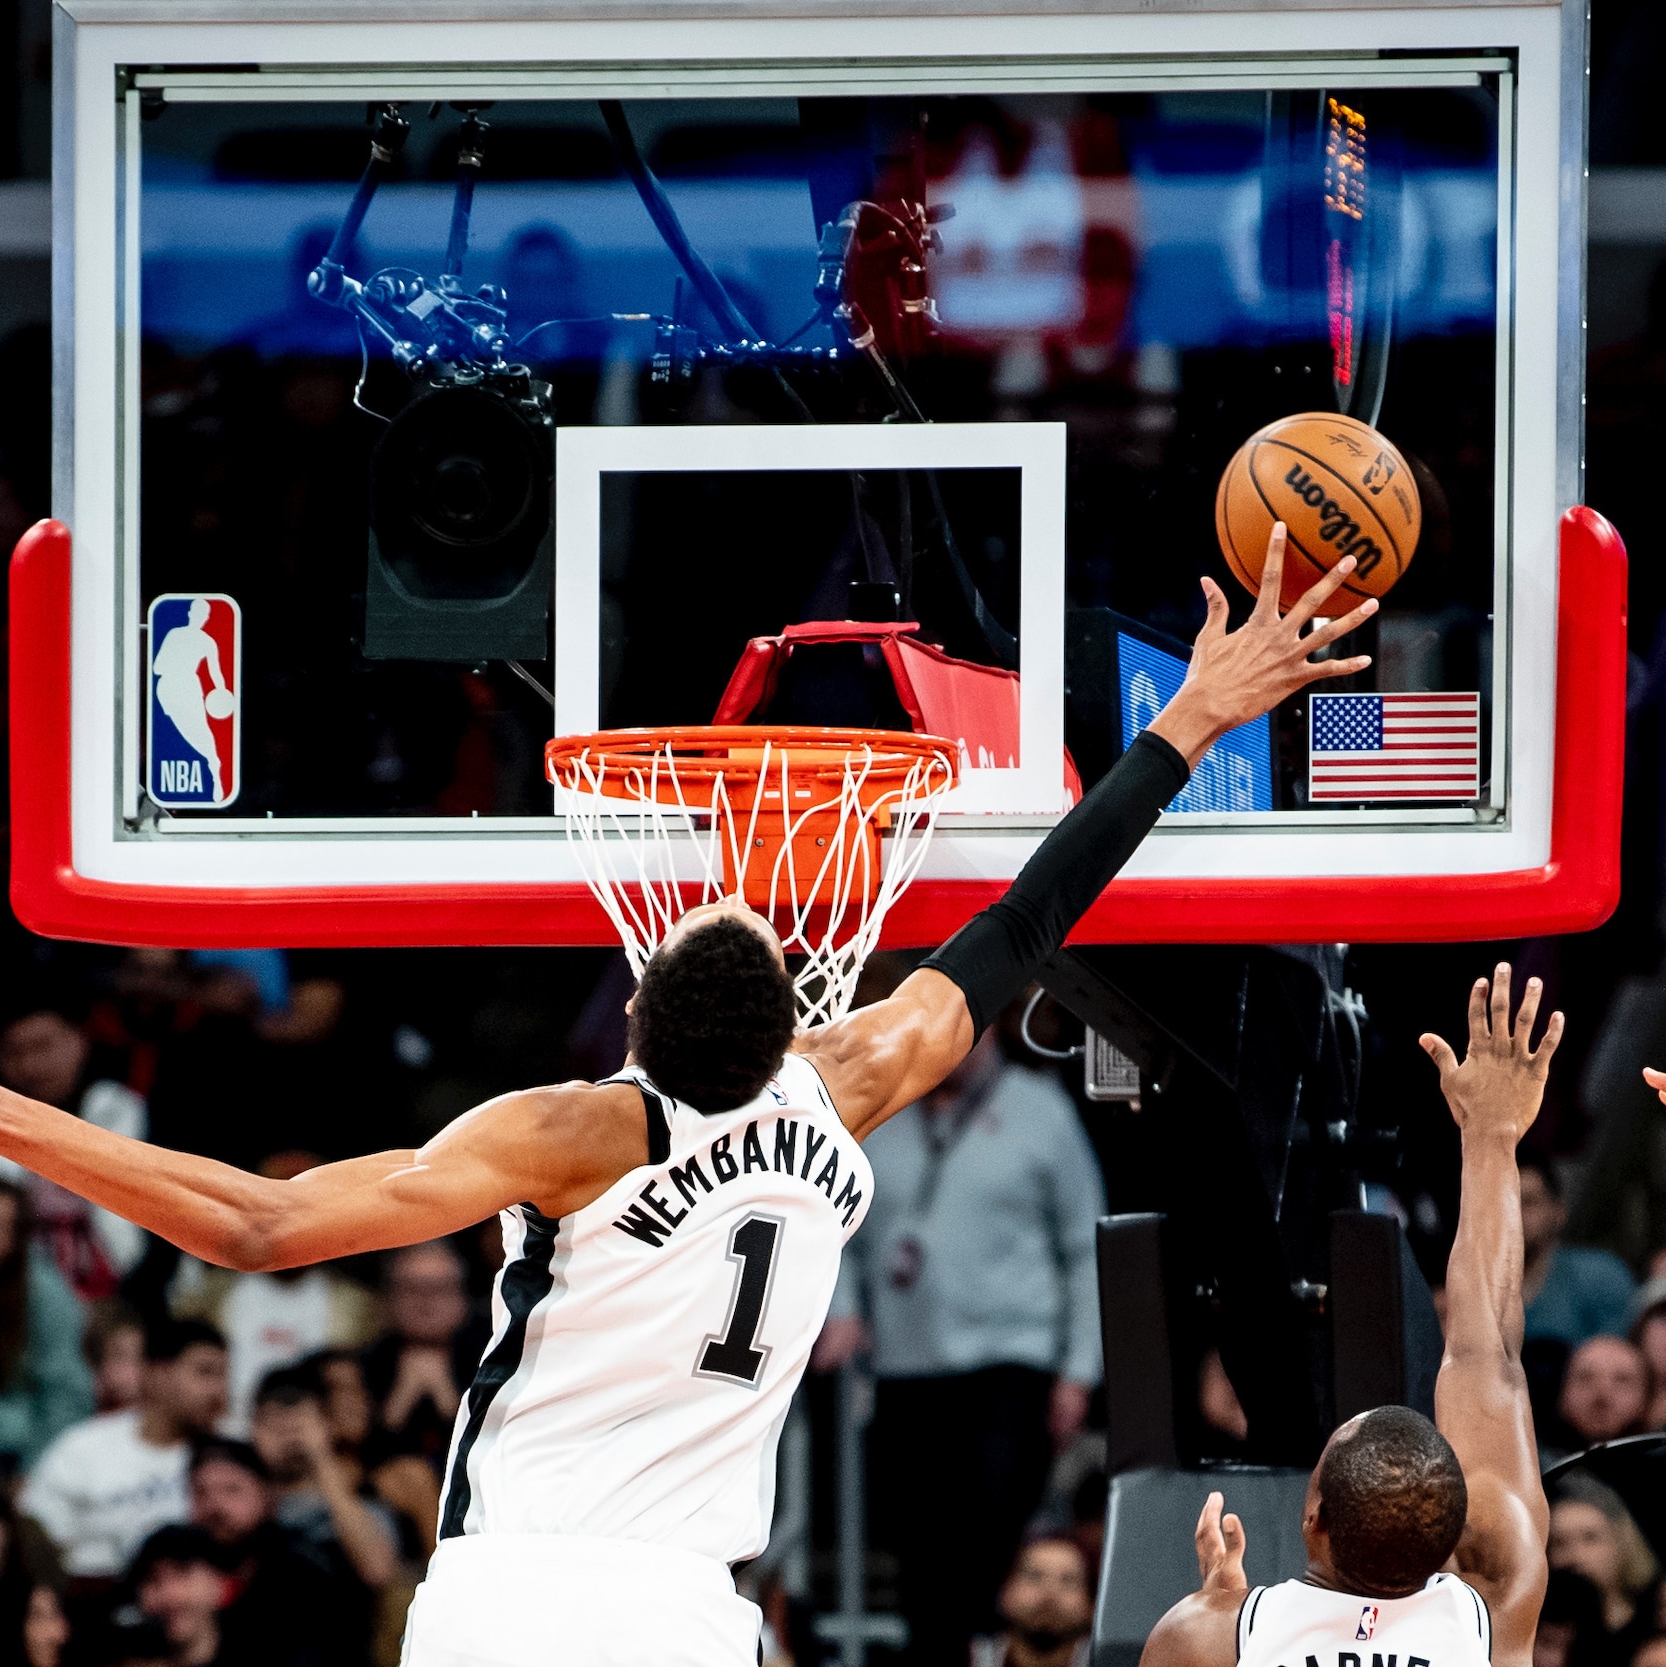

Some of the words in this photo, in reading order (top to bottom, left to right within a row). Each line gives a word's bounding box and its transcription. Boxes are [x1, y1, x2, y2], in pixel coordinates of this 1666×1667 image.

[1285, 462, 1383, 581] Wilson
[160, 759, 204, 793] NBA
[612, 1116, 863, 1248] WEMBANYAM
[692, 1211, 786, 1391] 1
